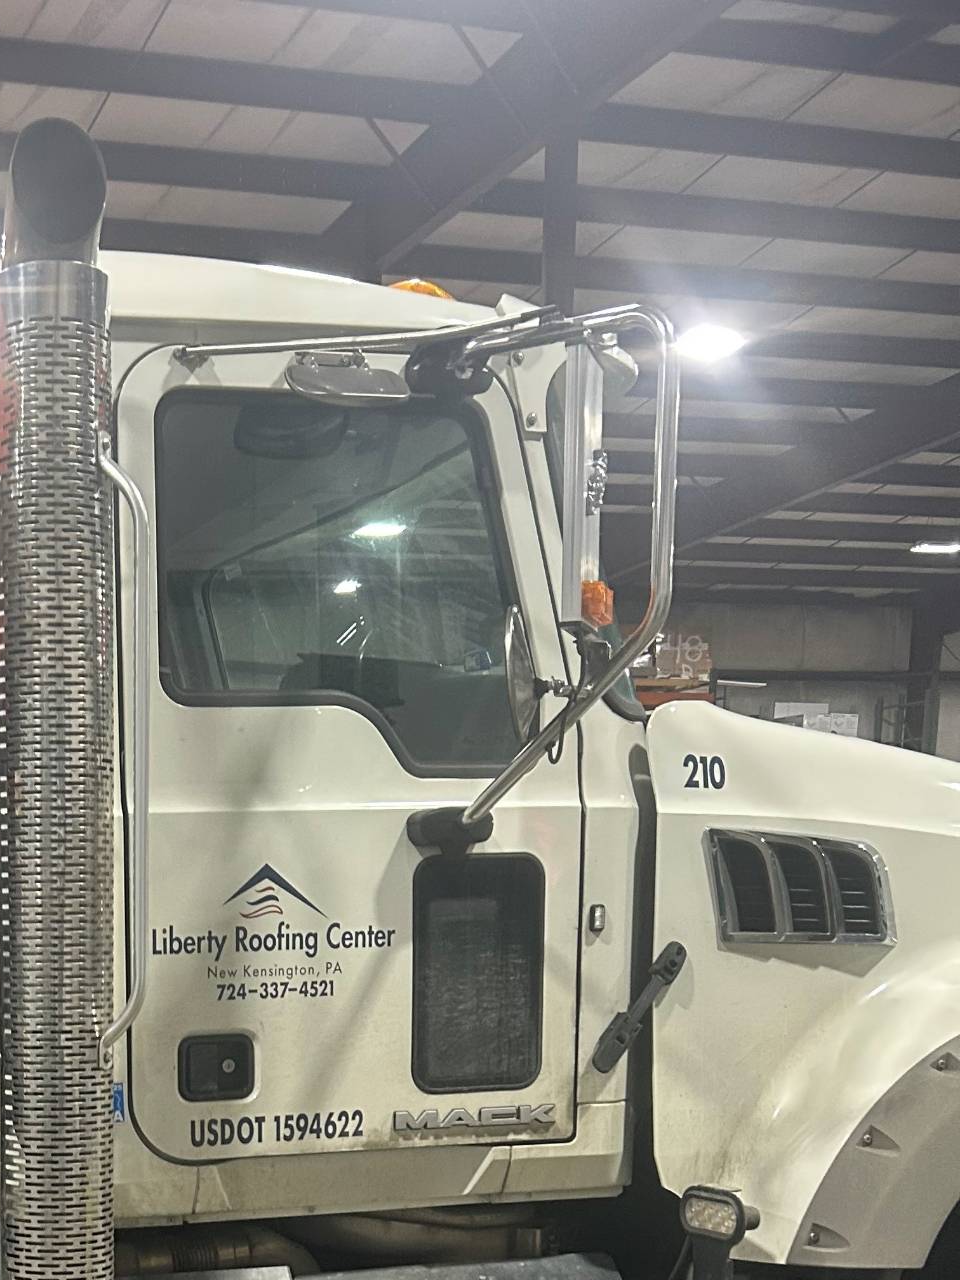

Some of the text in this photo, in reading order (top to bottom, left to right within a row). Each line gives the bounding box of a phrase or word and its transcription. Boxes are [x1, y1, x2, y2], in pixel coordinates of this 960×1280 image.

[682, 753, 726, 790] 210
[151, 921, 396, 962] Liberty Roofing Center
[207, 961, 342, 980] New Kensington, PA
[216, 980, 334, 1001] 724-337-4521
[190, 1110, 364, 1147] USDOT 1594622
[393, 1103, 556, 1132] MACK
